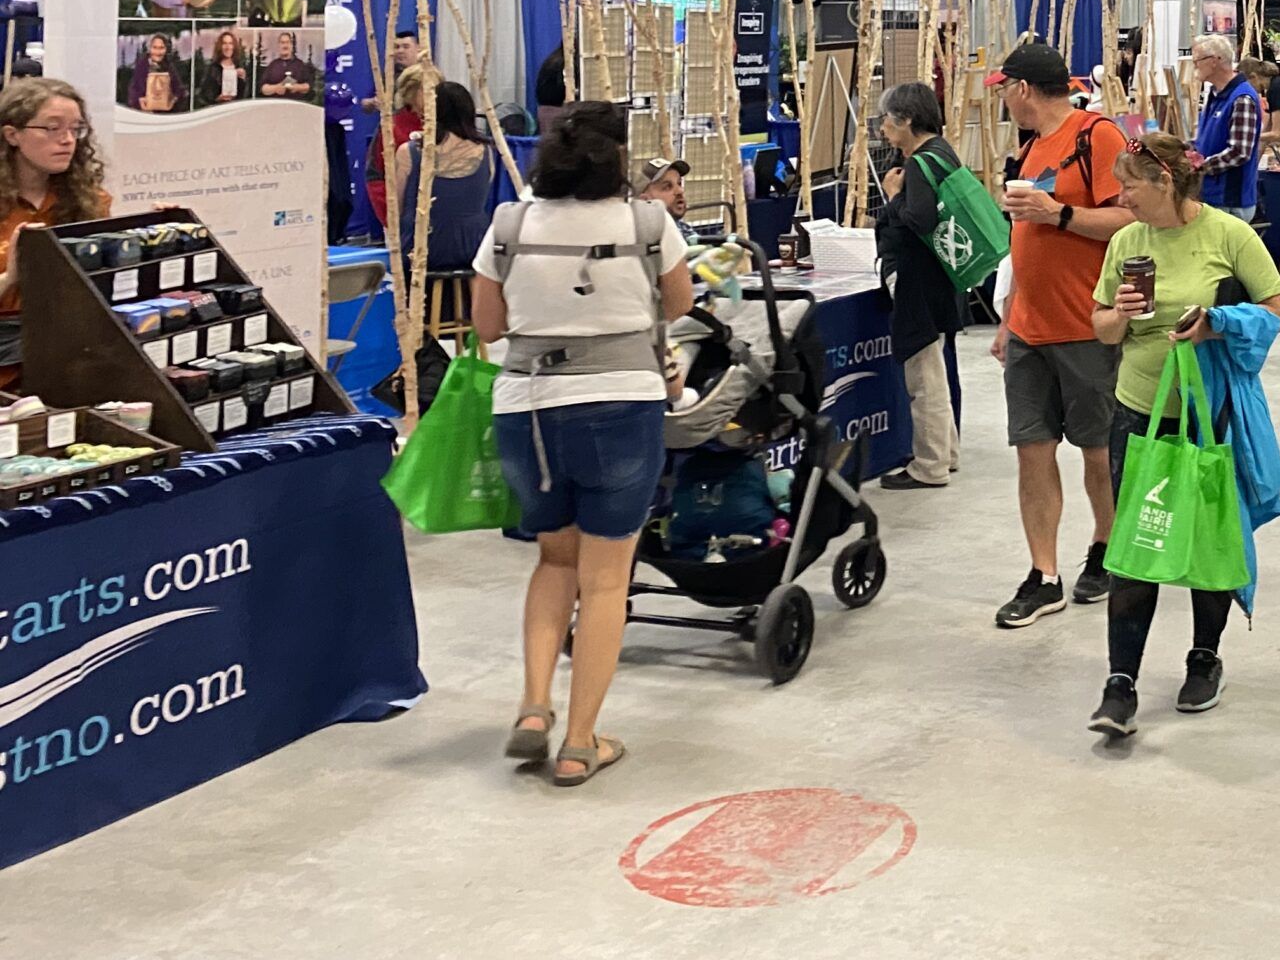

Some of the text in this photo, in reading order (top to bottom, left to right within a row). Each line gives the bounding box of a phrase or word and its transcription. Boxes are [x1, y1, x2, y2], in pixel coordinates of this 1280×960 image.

[123, 160, 306, 187] EACH PIECE OF ART TELLS A STORY
[147, 190, 168, 200] Arts
